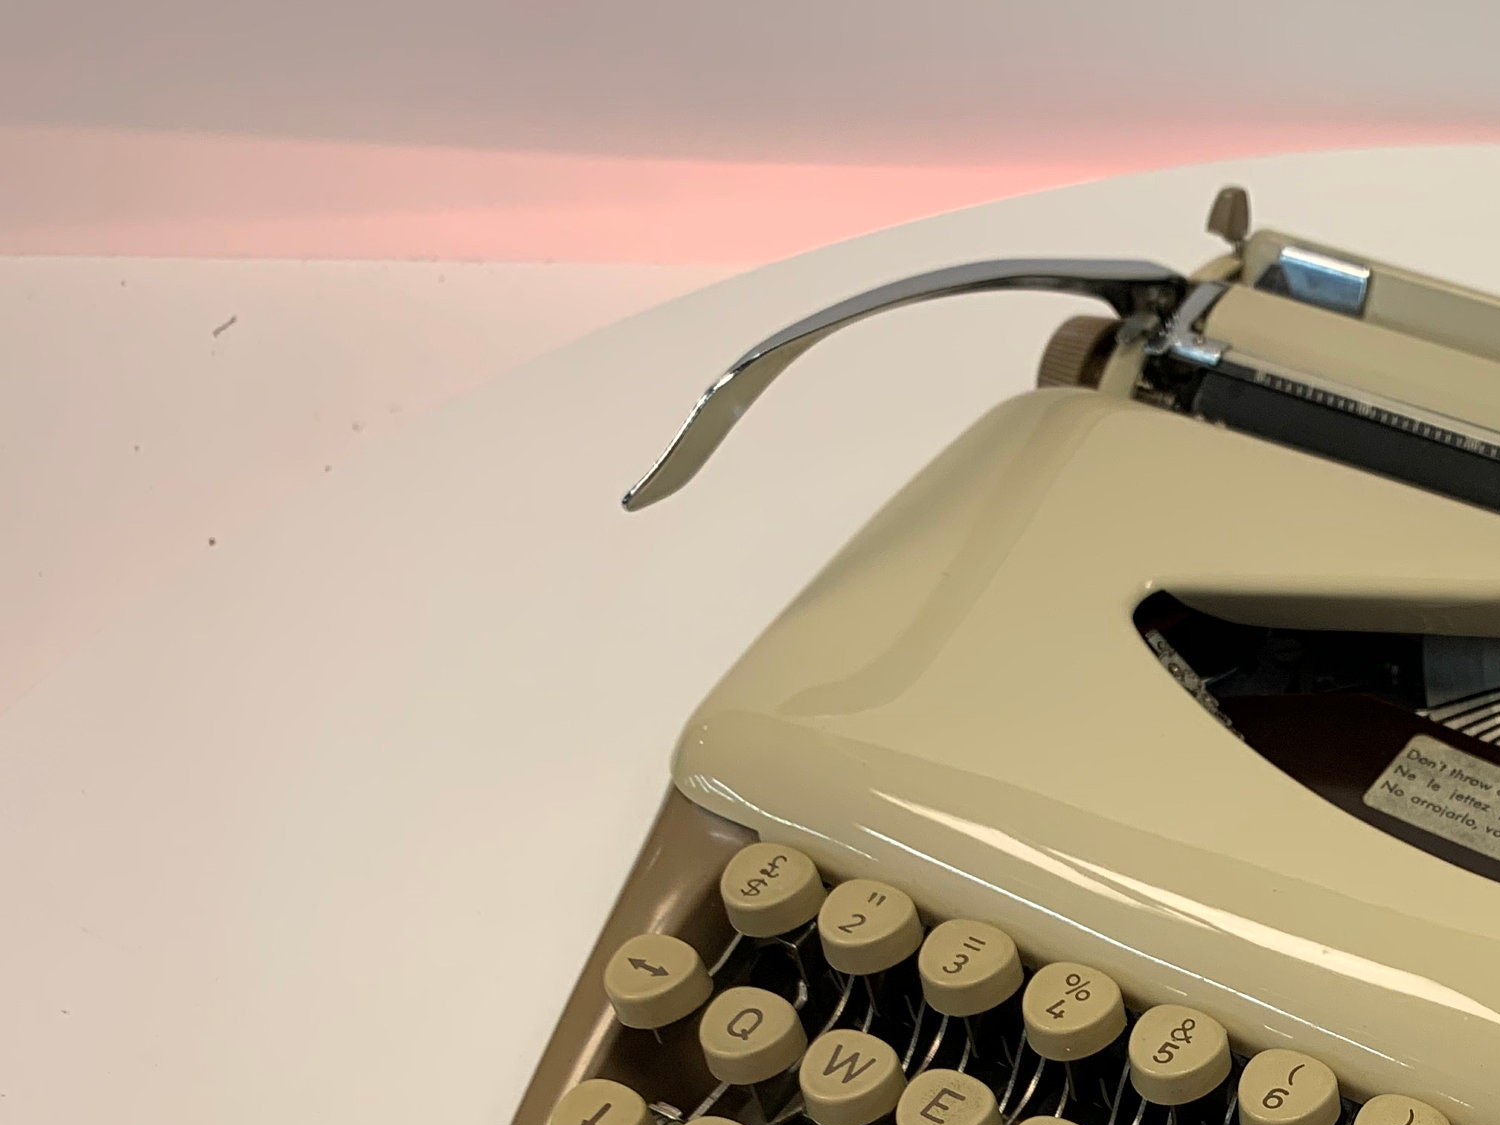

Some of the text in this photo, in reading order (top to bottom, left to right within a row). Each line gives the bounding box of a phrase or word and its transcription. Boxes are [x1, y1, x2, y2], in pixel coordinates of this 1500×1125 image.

[1406, 749, 1447, 771] Don't
[1450, 768, 1493, 791] throw
[1394, 765, 1417, 781] Ne
[1426, 778, 1441, 792] le
[1449, 788, 1491, 812] jettez
[1380, 780, 1404, 797] No
[1410, 795, 1478, 830] arrojarlo,
[758, 855, 788, 881] £
[740, 878, 768, 897] $
[837, 913, 867, 934] 2
[942, 953, 970, 974] 3
[1065, 973, 1091, 1002] %
[1045, 999, 1066, 1020] 4
[726, 1007, 764, 1041] Q
[1170, 1018, 1196, 1045] &
[822, 1044, 877, 1084] W
[1152, 1041, 1178, 1064] 5
[919, 1087, 966, 1125] E
[1262, 1087, 1290, 1110] 6
